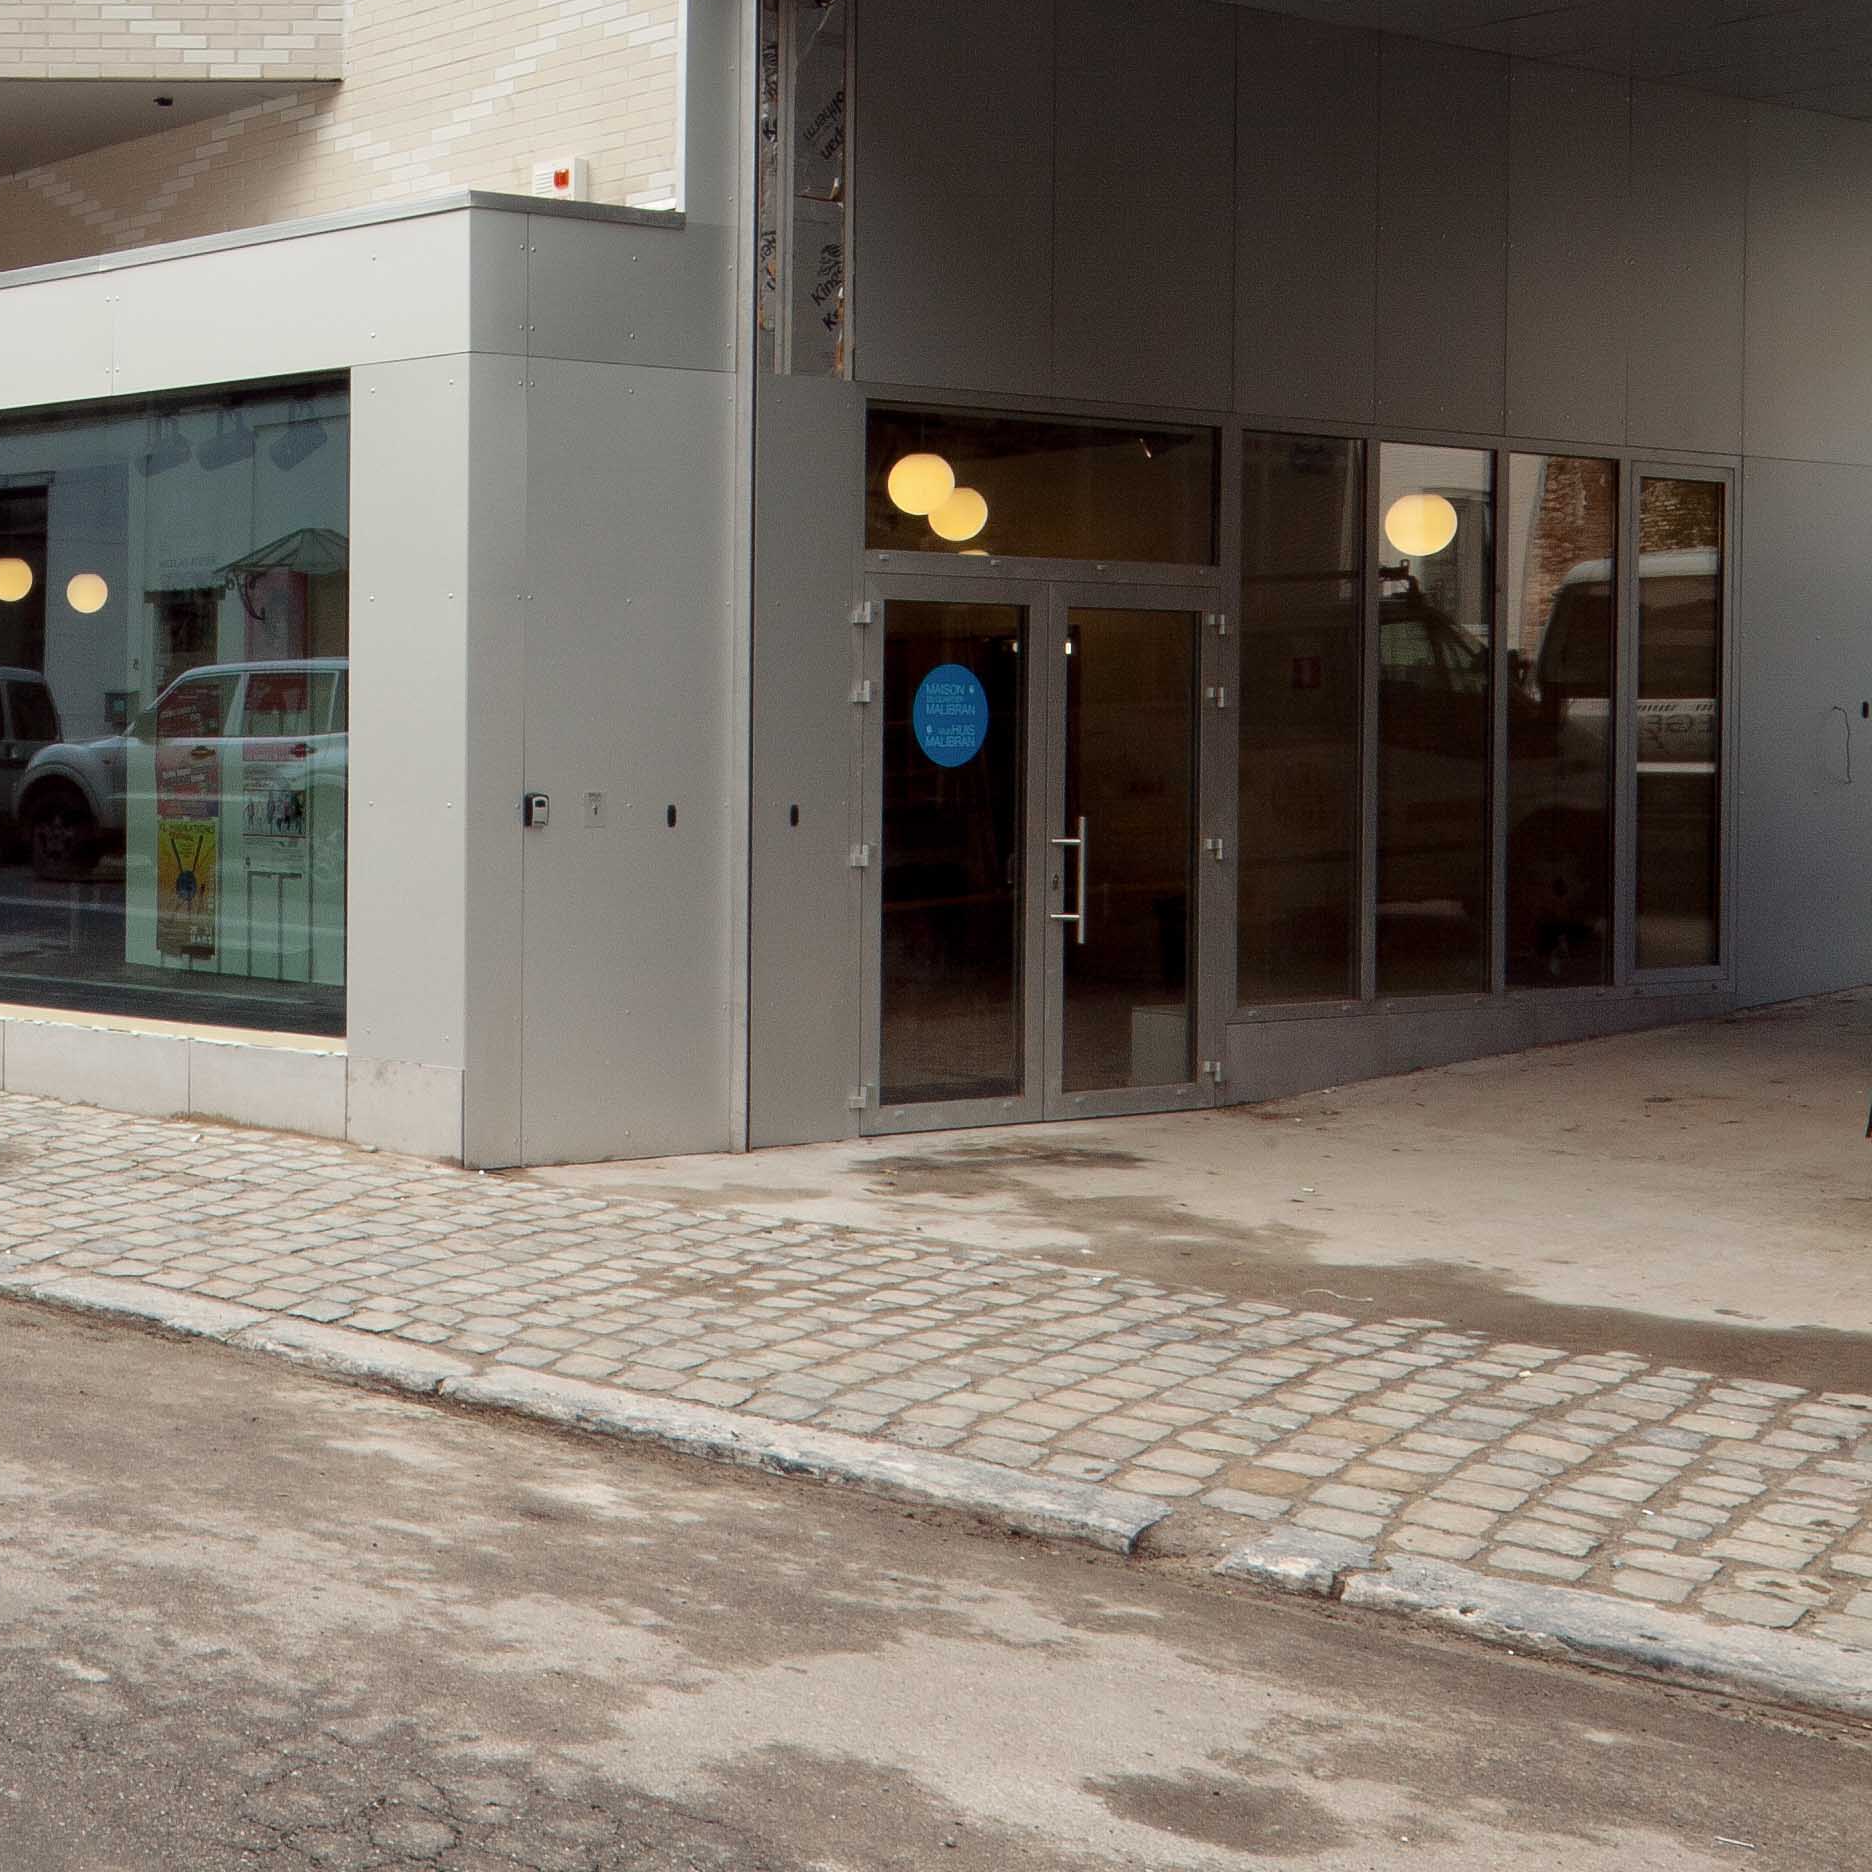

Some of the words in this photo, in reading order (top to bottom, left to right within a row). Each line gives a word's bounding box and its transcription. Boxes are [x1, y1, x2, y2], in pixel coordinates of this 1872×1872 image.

[926, 683, 965, 696] MAISON
[926, 704, 976, 715] MALIBRAN
[925, 736, 976, 747] MALIBRAN
